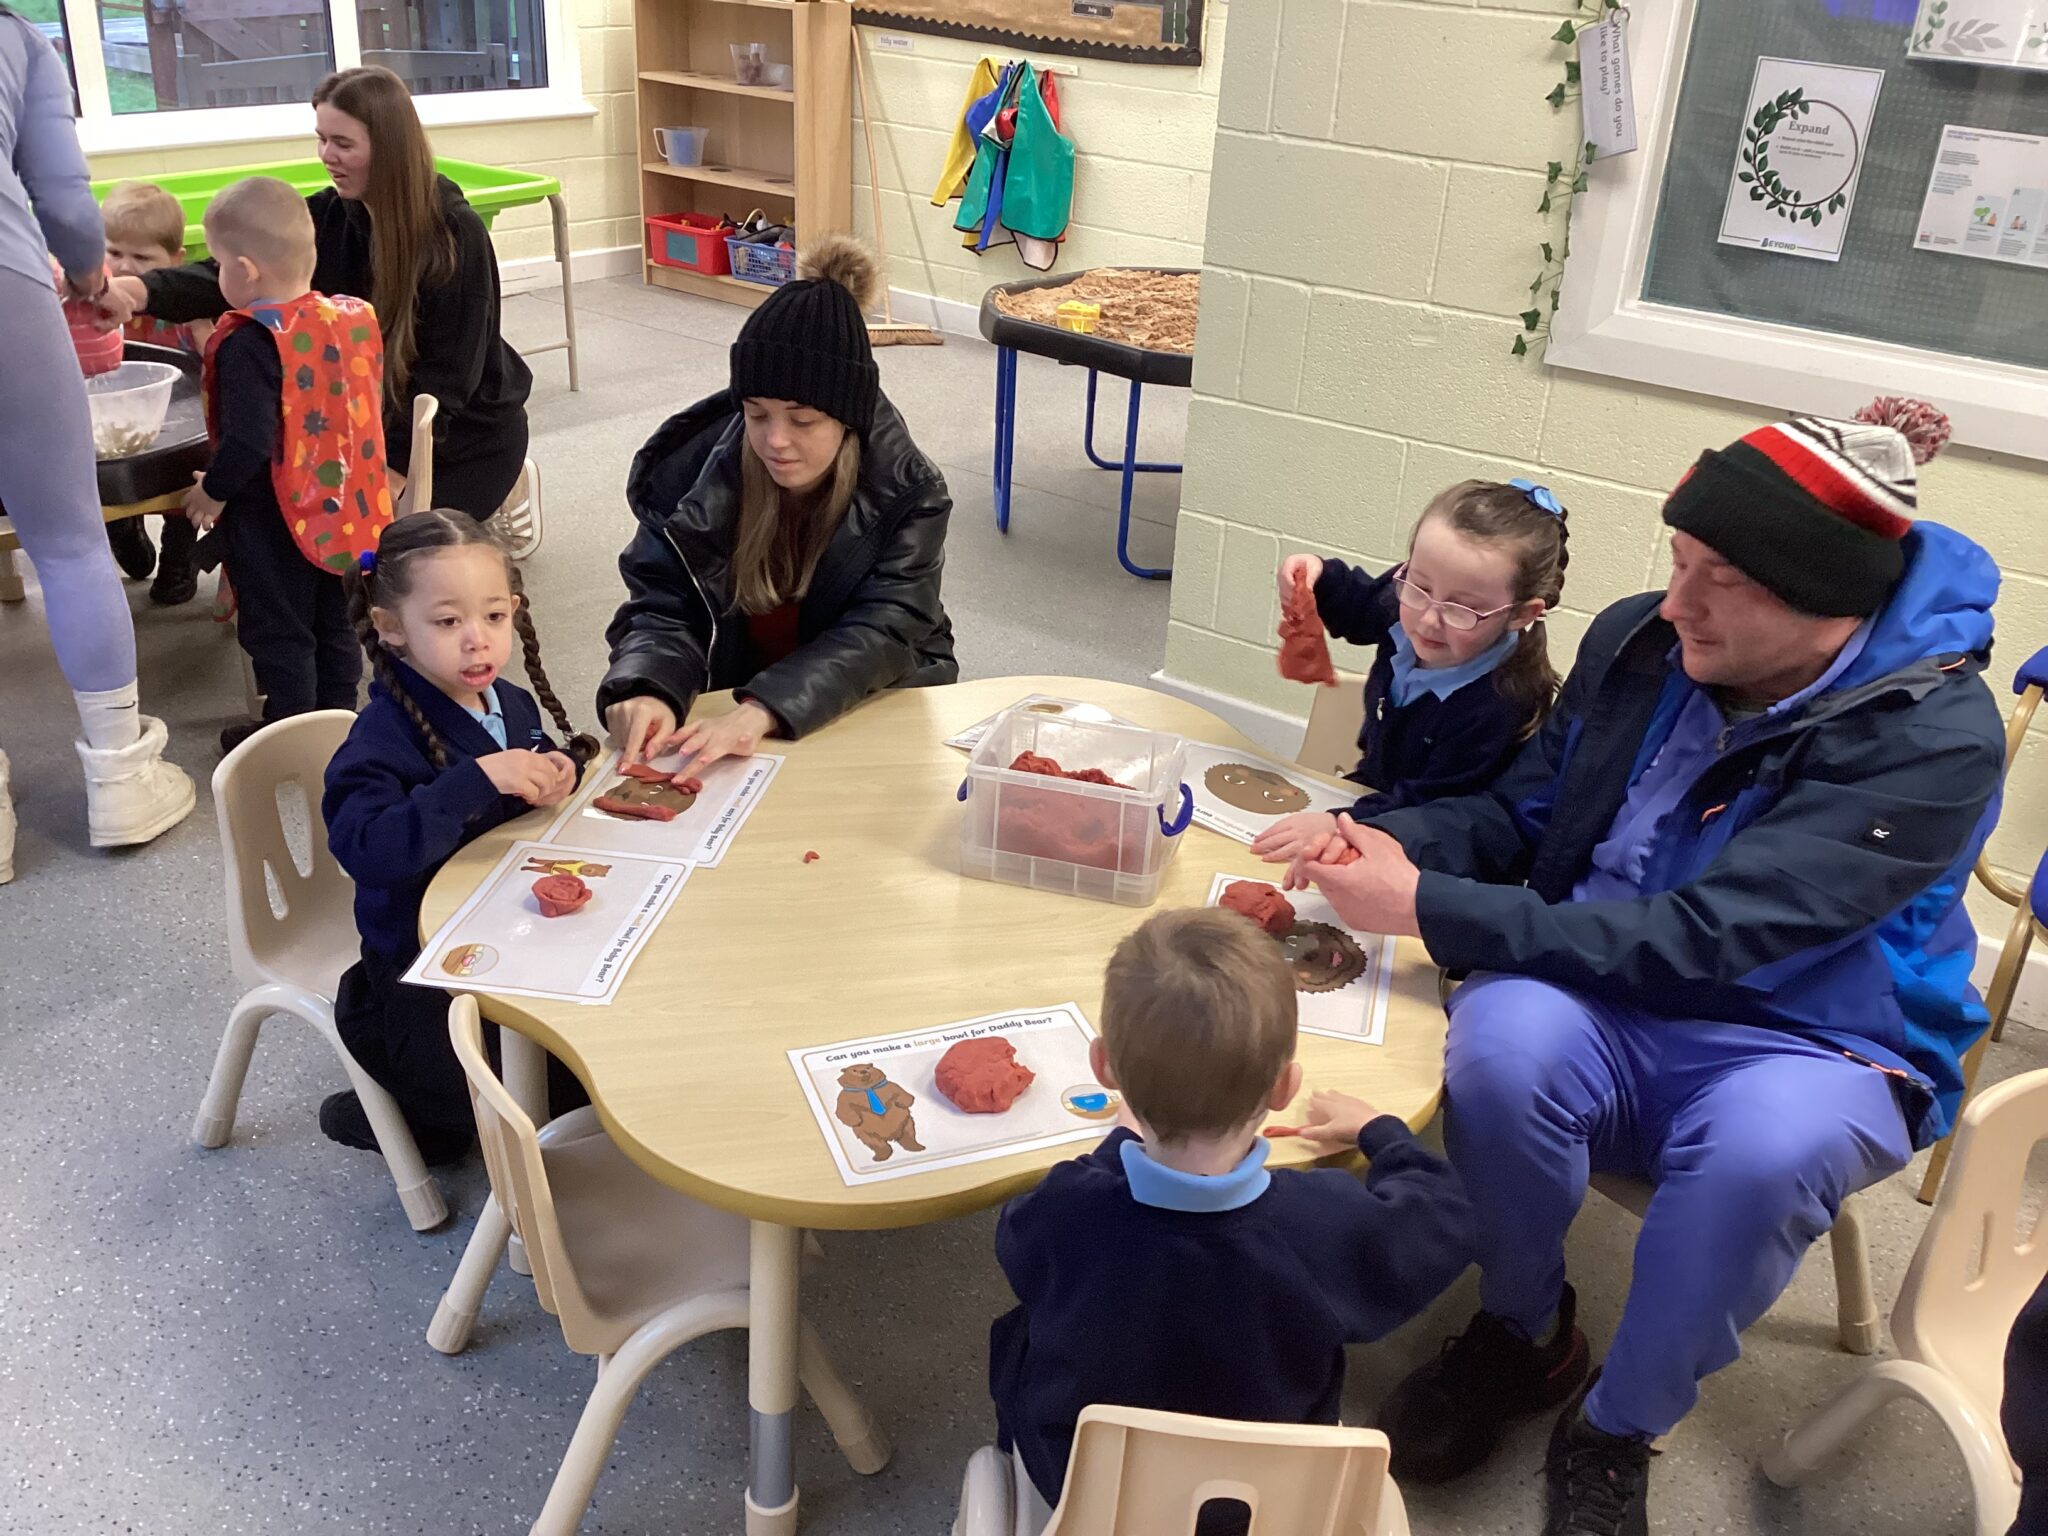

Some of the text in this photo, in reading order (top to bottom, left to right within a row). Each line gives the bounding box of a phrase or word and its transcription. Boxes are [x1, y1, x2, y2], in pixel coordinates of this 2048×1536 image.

[1599, 26, 1610, 96] like to play?
[1610, 21, 1624, 137] What games do you
[1788, 120, 1830, 135] Expand
[1761, 237, 1796, 250] BEYOND
[752, 769, 763, 777] Can
[748, 777, 756, 785] you
[740, 785, 751, 797] make
[711, 824, 726, 834] Baby
[704, 835, 718, 850] Bear?
[659, 874, 672, 884] Can
[653, 884, 664, 894] you
[644, 895, 657, 908] make
[621, 927, 638, 939] bowl
[617, 939, 629, 947] for
[604, 948, 622, 963] Baby
[595, 963, 612, 983] Bear?
[825, 1054, 848, 1062] Can
[850, 1049, 870, 1059] you
[872, 1044, 902, 1054] make
[913, 1037, 940, 1049] large
[943, 1031, 969, 1042] bowl
[970, 1028, 986, 1037] for
[988, 1020, 1023, 1032] Daddy
[1023, 1017, 1052, 1026] Bear?
